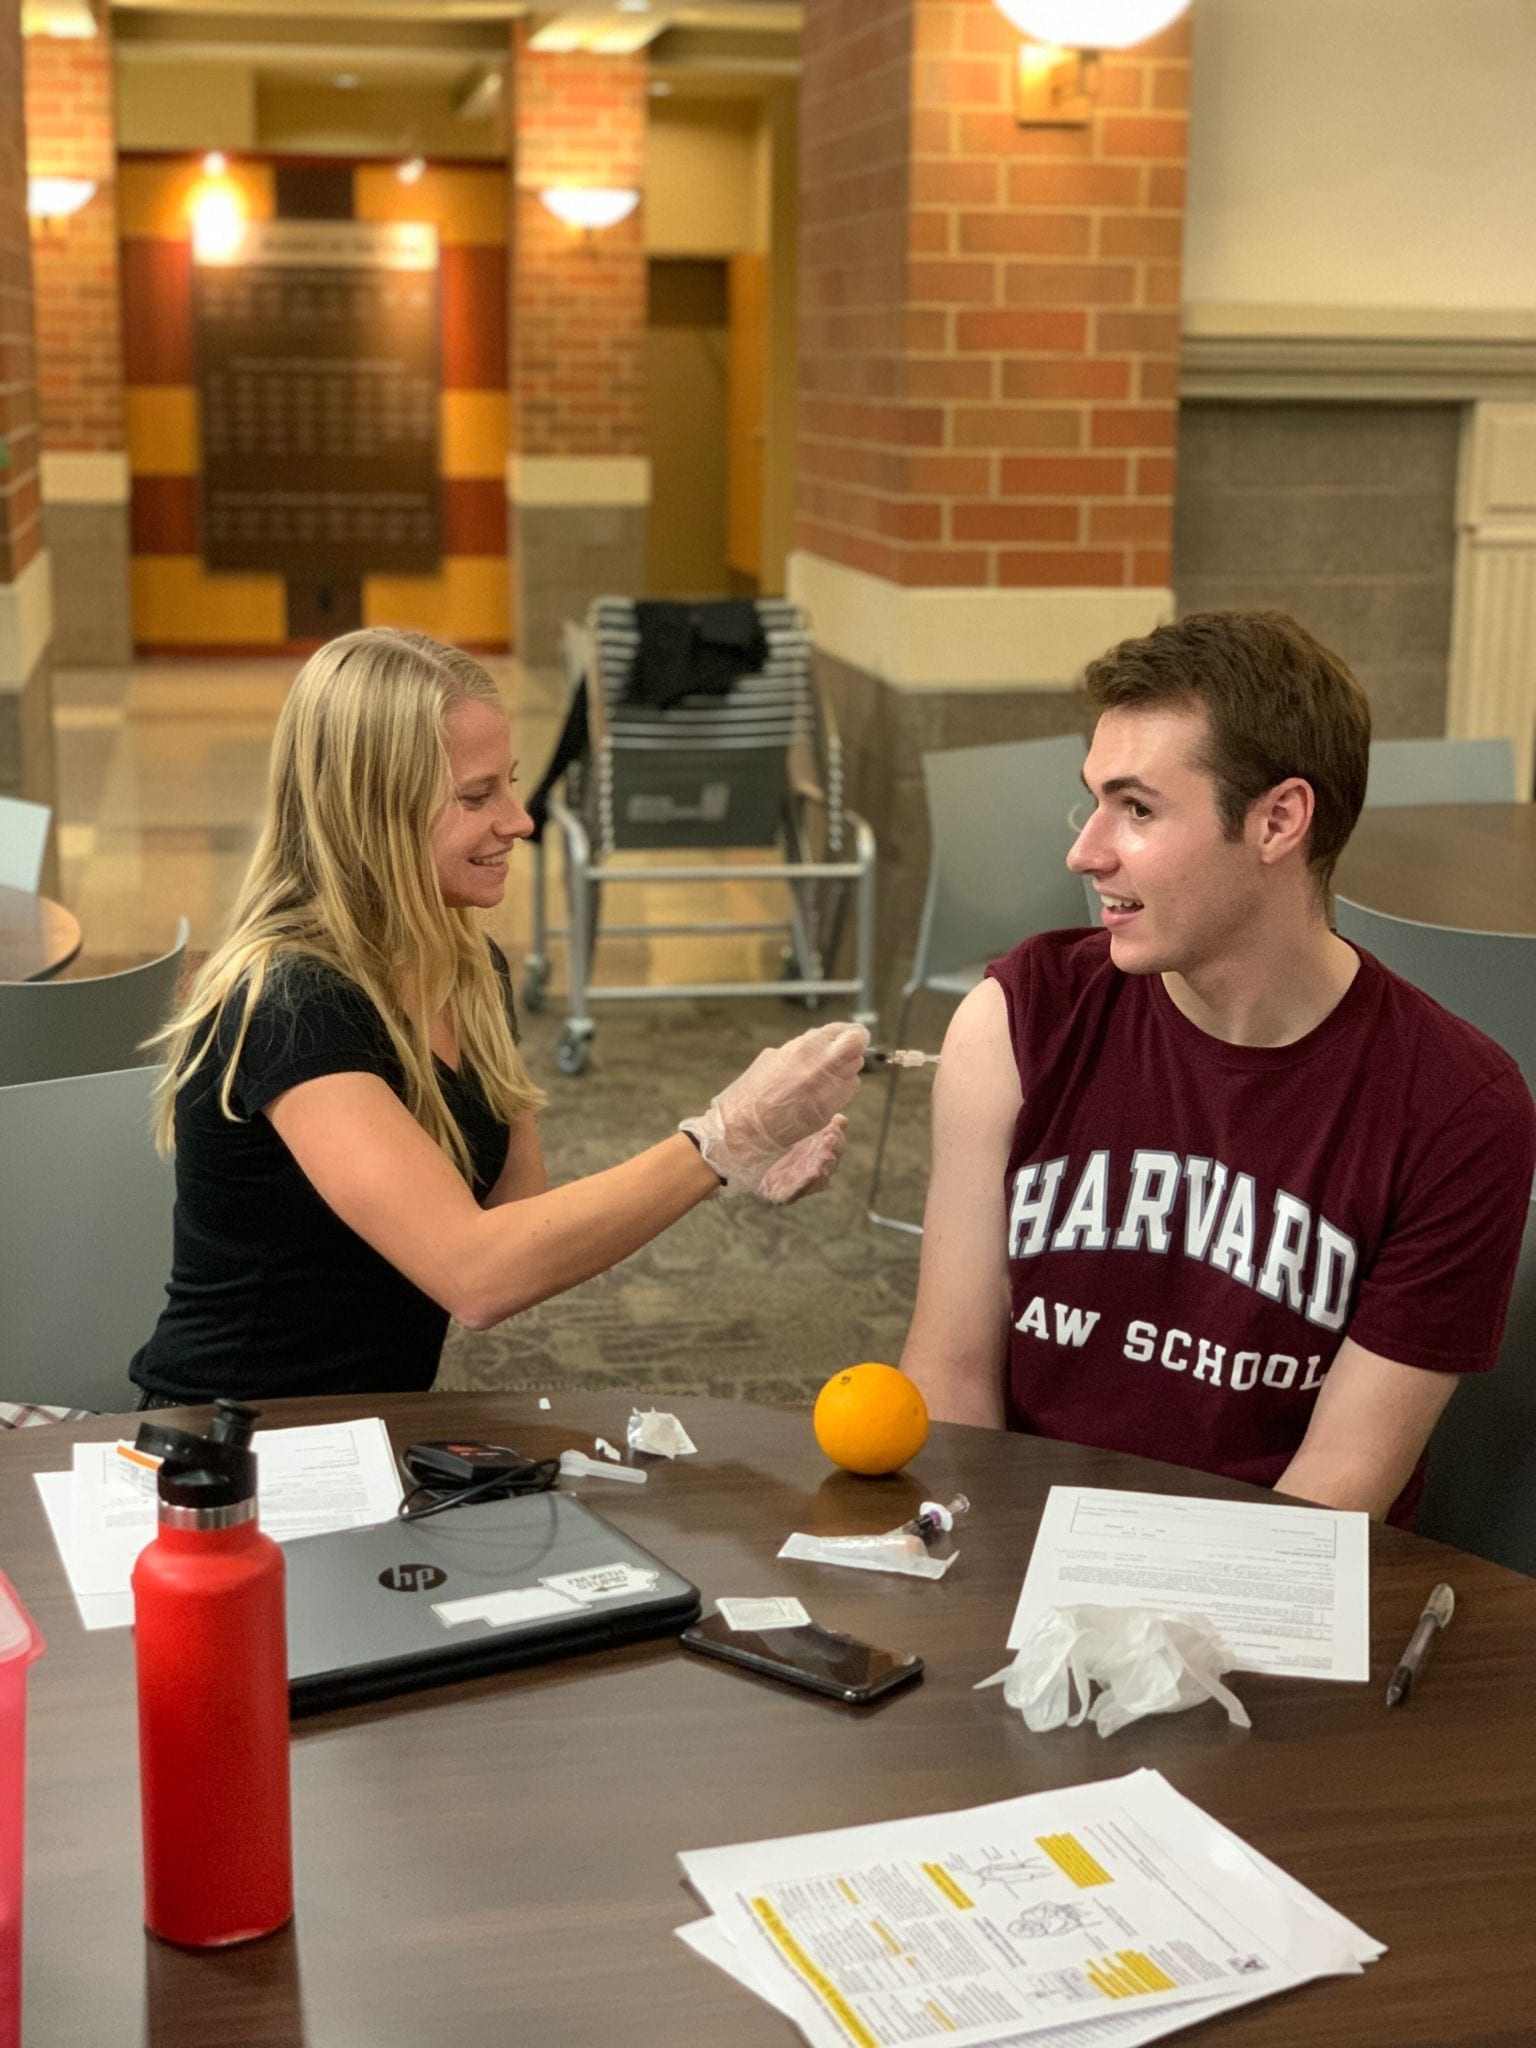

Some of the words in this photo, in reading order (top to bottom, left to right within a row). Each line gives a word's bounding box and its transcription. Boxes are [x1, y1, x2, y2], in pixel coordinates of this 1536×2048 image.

[1009, 1149, 1358, 1332] HARVARD
[1011, 1296, 1100, 1347] AW
[1123, 1320, 1326, 1391] SCHOOL
[392, 1564, 435, 1592] hp
